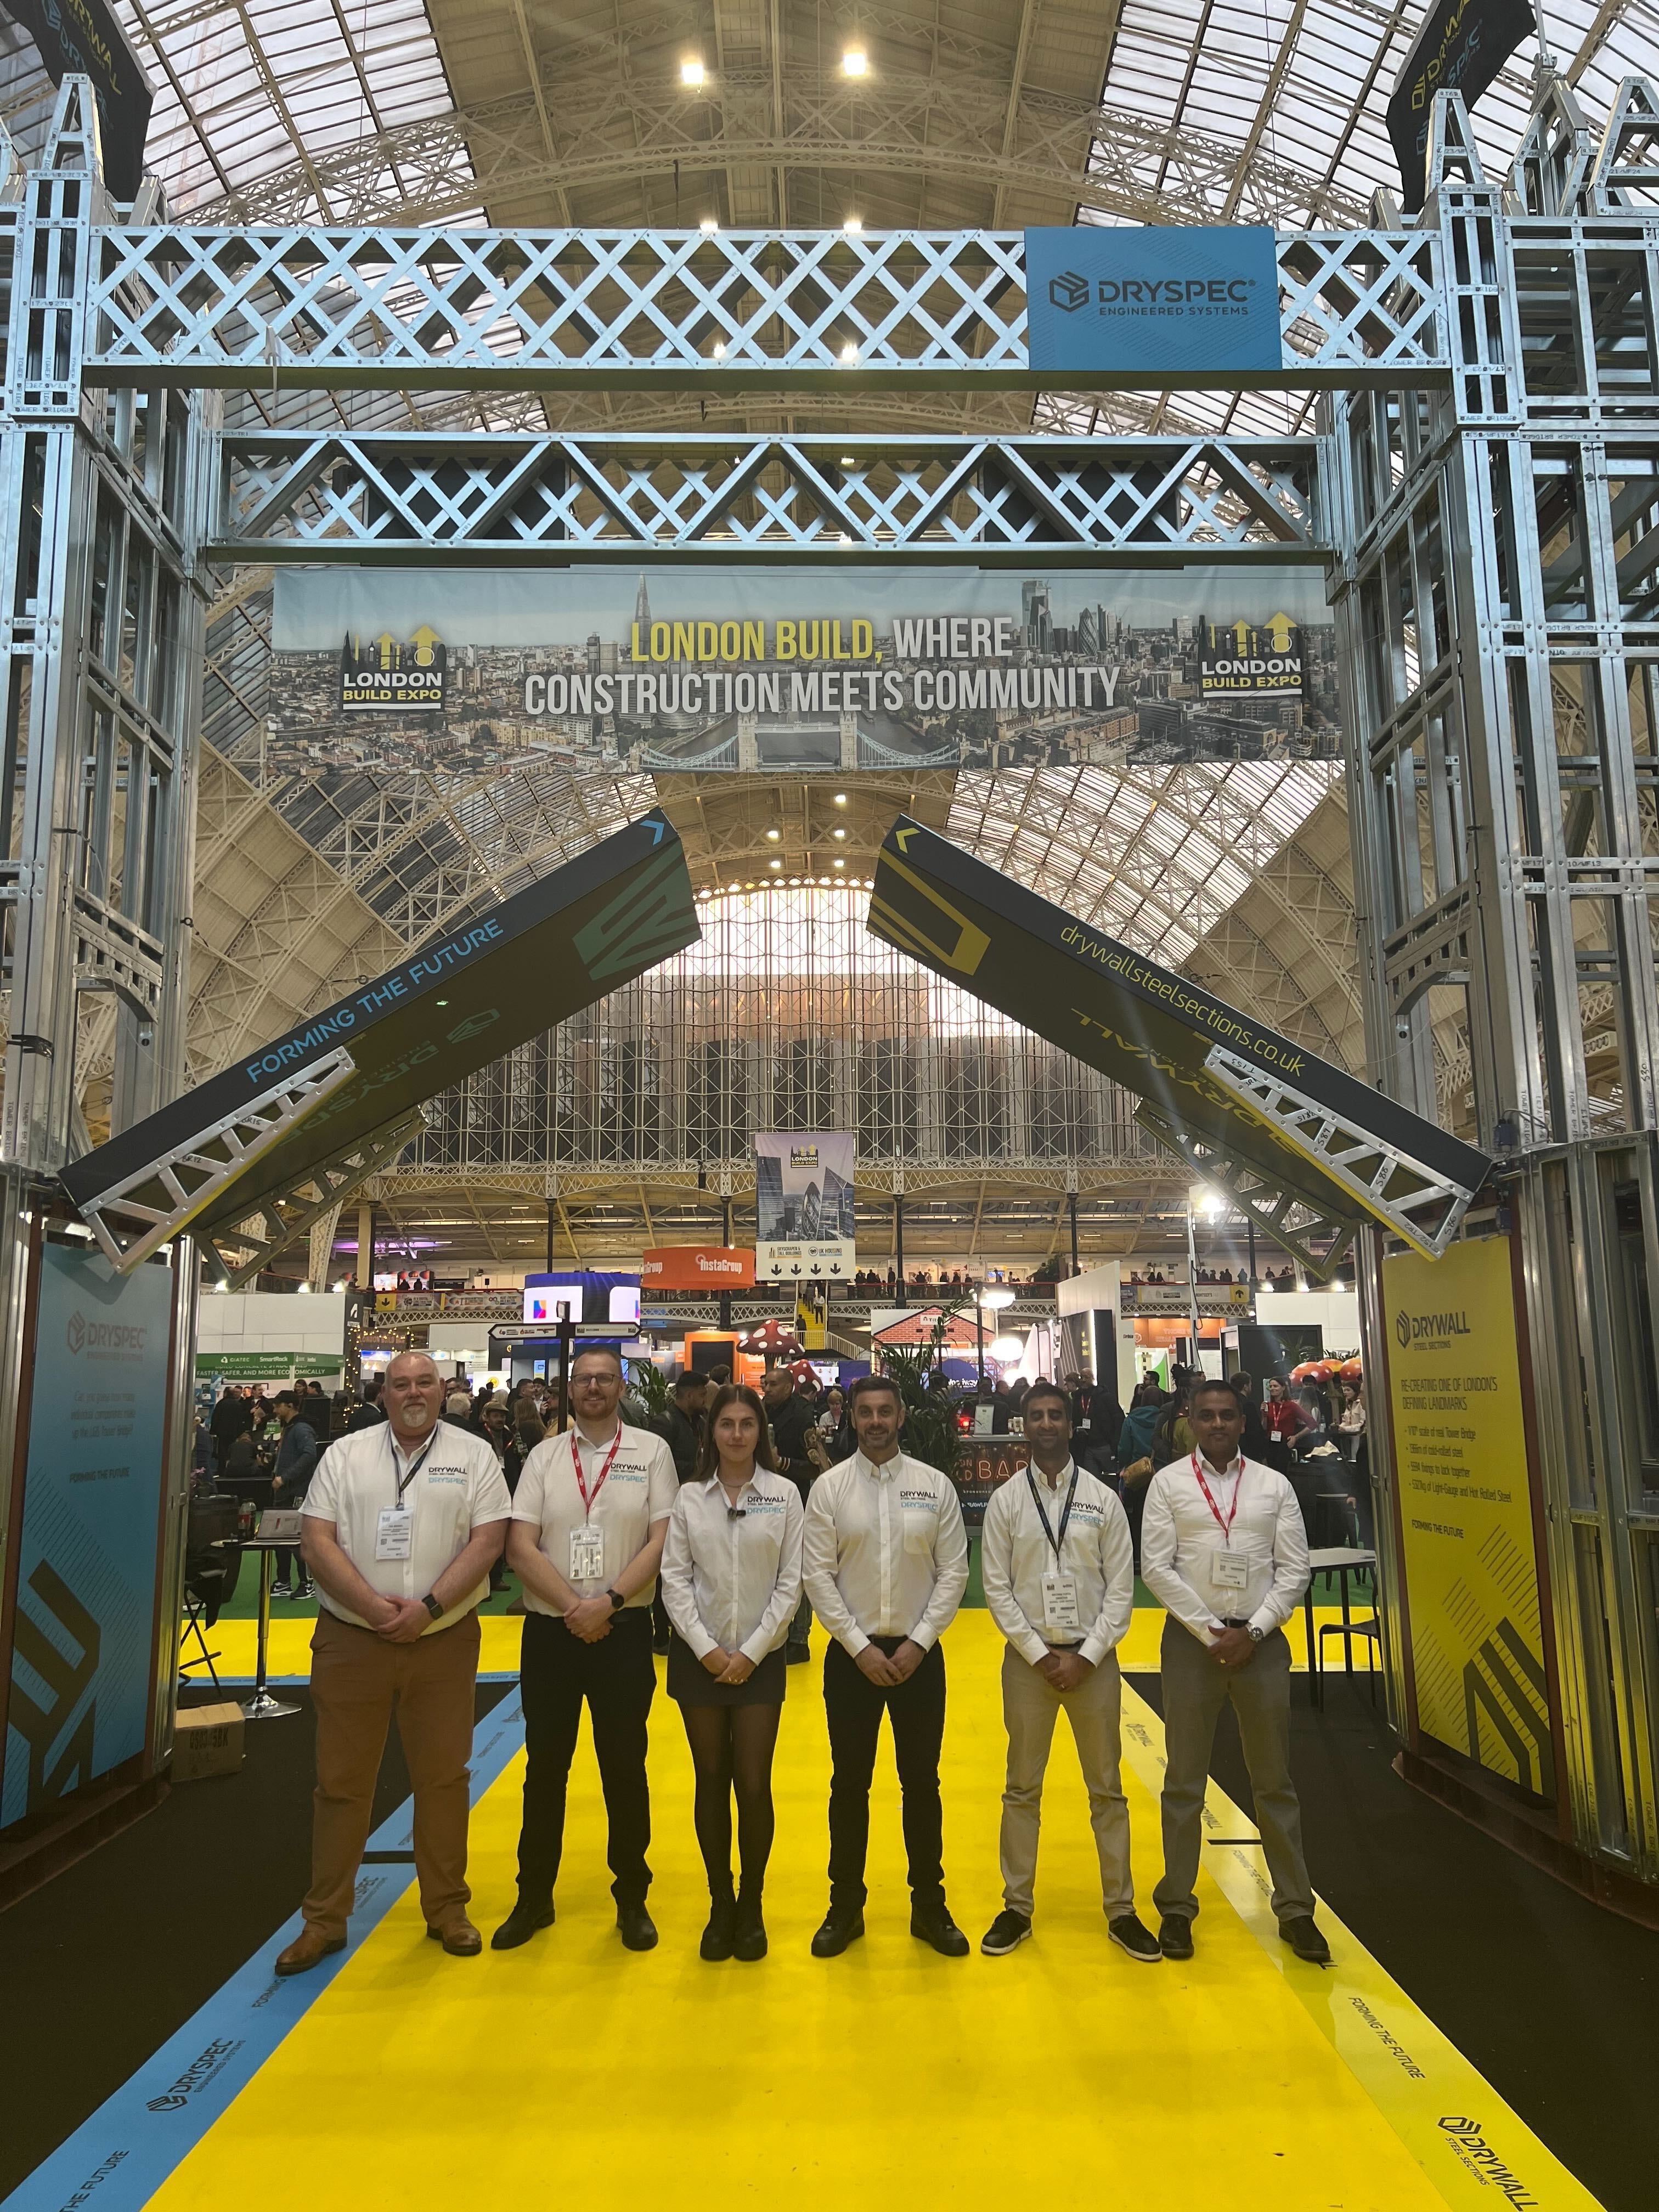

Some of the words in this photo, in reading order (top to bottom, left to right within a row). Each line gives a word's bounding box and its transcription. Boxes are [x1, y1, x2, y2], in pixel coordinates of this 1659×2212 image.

[1099, 307, 1183, 316] ENGINEERED
[1188, 306, 1249, 316] SYSTEMS
[632, 620, 764, 661] LONDON
[776, 620, 883, 664] BUILD,
[893, 618, 1013, 659] WHERE
[1202, 659, 1302, 675] LONDON
[343, 672, 443, 687] LONDON
[1202, 677, 1251, 689] BUILD
[1256, 675, 1302, 687] EXPO
[343, 689, 392, 701] BUILD
[397, 689, 442, 701] EXPO
[525, 673, 780, 714] CONSTRUCTION
[791, 670, 904, 712] MEETS
[915, 667, 1120, 712] COMMUNITY
[246, 1009, 356, 1083] FORMING
[357, 976, 409, 1013] THE
[409, 918, 504, 984] FUTURE
[1060, 925, 1307, 1077] drywallsteelsections.co.uk
[1071, 1008, 1263, 1128] DRYWALL
[700, 1259, 742, 1274] InstaGroup
[1412, 1311, 1471, 1339] DRYWALL
[87, 1322, 146, 1350] DRYSPEC
[1401, 1378, 1438, 1392] RE-CREATING
[1439, 1378, 1452, 1391] ONE
[1453, 1378, 1462, 1391] OF
[1464, 1376, 1498, 1391] LONDON'S
[1402, 1397, 1427, 1410] DEFINING
[1429, 1397, 1468, 1410] LANDMARKS
[611, 1463, 647, 1471] DRYWALL
[428, 1477, 467, 1485] DRYSPEC
[610, 1474, 647, 1483] DRYSPEC
[900, 1491, 938, 1499] DRYWALL
[900, 1501, 938, 1511] DRYSPEC
[1070, 1502, 1104, 1515] DRYWALL
[1412, 1519, 1432, 1532] FORMING
[1432, 1523, 1443, 1534] THE
[1443, 1526, 1464, 1539] FUTURE
[251, 1978, 287, 2008] FORMING
[1347, 1997, 1384, 2030] FORMING
[1375, 2030, 1398, 2045] THE
[1388, 2045, 1426, 2080] FUTURE
[1444, 2137, 1465, 2157] STEEL
[1460, 2156, 1491, 2186] SECTIONS
[80, 2149, 131, 2191] FUTURE
[1459, 2137, 1539, 2212] DRYWALL
